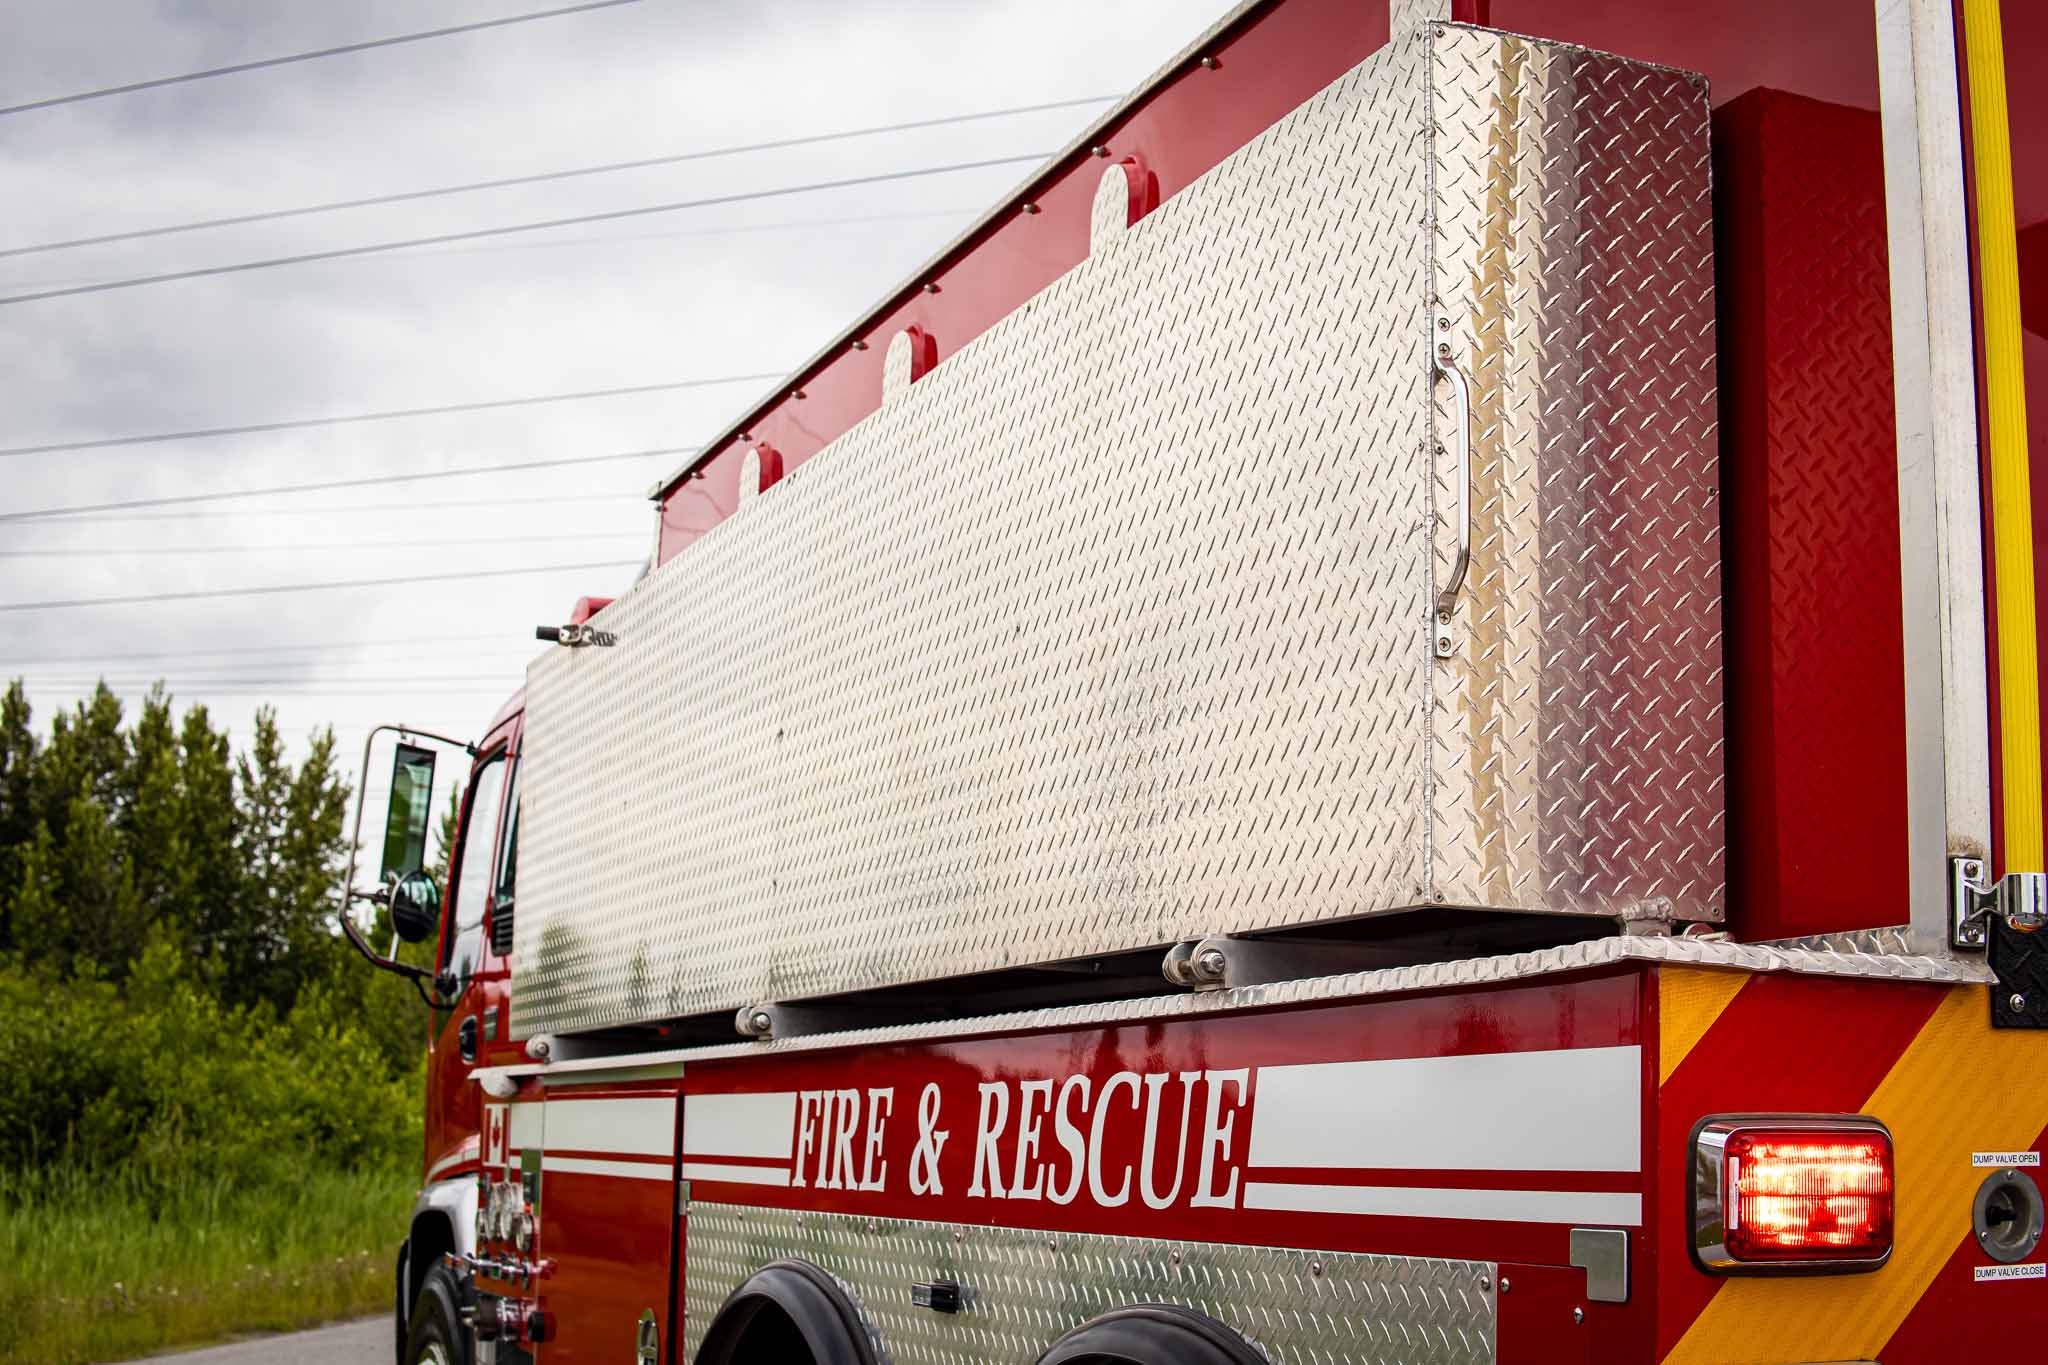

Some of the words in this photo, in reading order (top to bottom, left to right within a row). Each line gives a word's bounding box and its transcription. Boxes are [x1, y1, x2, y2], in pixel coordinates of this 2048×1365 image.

[792, 1087, 894, 1192] FIRE
[909, 1082, 949, 1196] &
[967, 1068, 1250, 1210] RESCUE
[1973, 1154, 1994, 1164] DUMP
[1995, 1154, 2018, 1164] VALVE
[2018, 1154, 2038, 1163] OPEN
[1975, 1268, 1997, 1278] DUMP
[1997, 1267, 2020, 1277] VALVE
[2020, 1266, 2045, 1275] CLOSE
